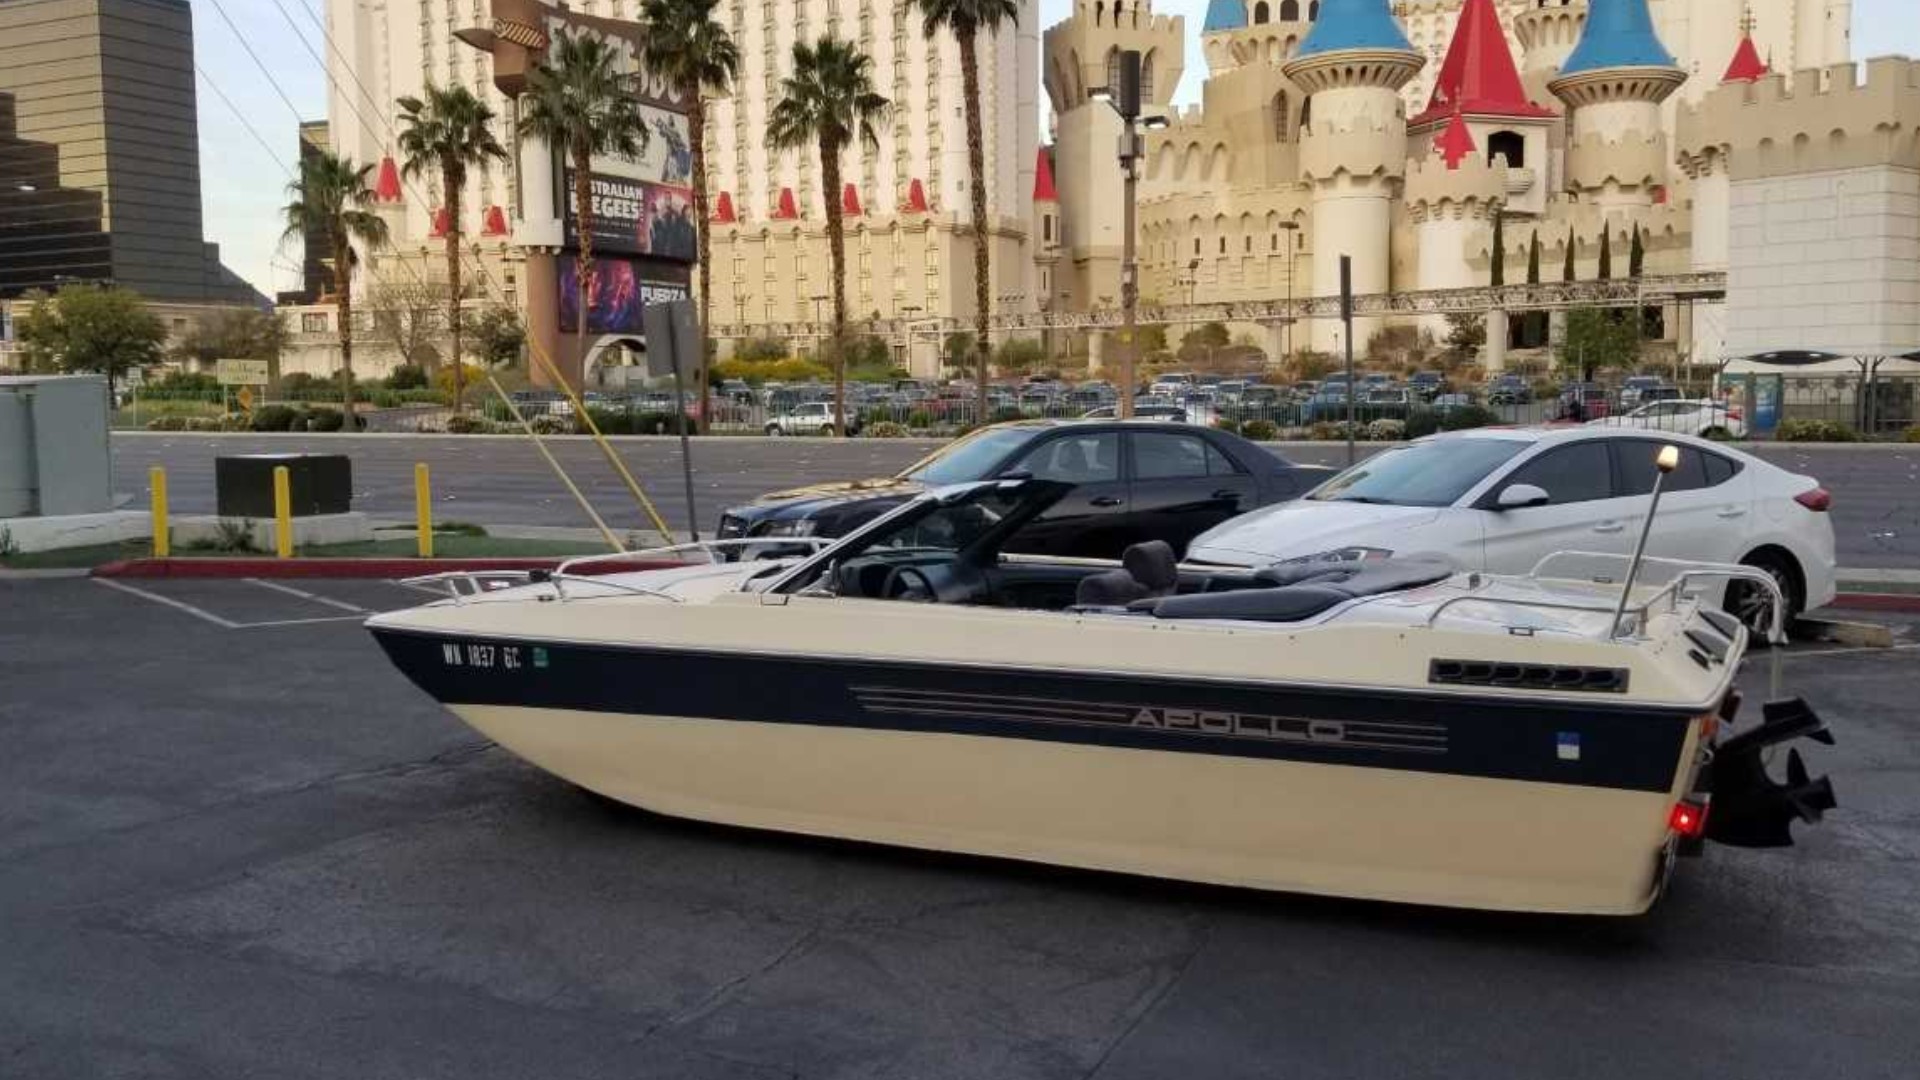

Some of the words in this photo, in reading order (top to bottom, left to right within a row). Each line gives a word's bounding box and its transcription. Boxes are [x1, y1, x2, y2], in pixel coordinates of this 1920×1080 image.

[641, 286, 686, 303] FUERZA
[468, 645, 494, 667] 1837
[1131, 708, 1345, 742] APOLLO
